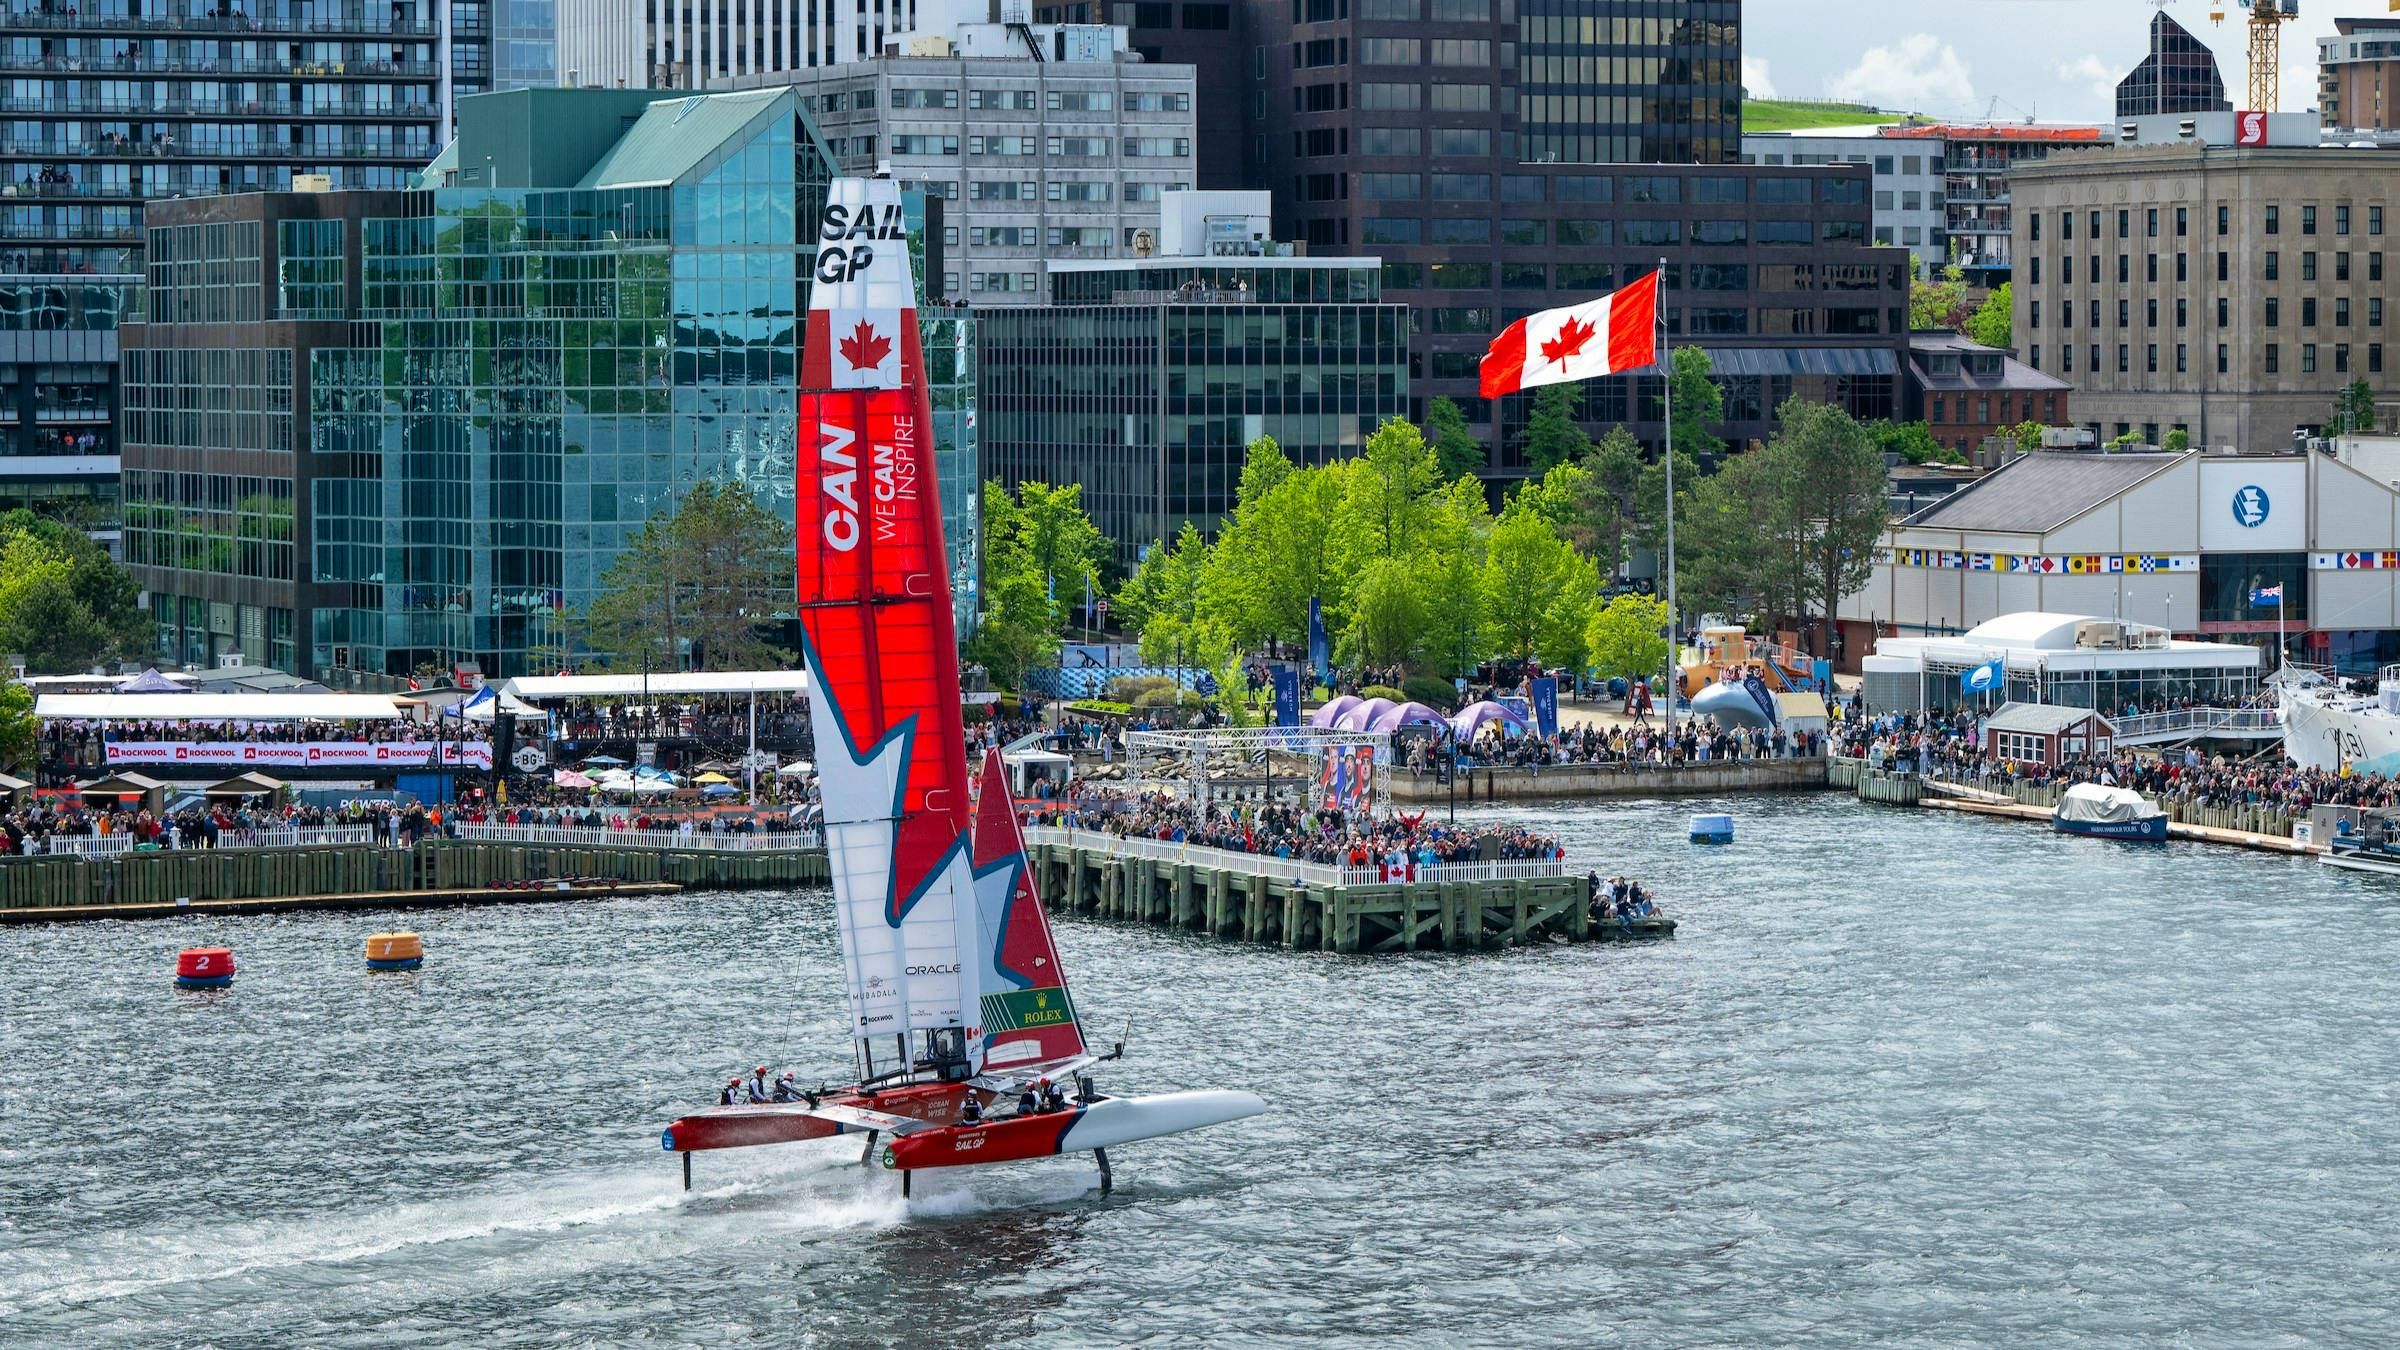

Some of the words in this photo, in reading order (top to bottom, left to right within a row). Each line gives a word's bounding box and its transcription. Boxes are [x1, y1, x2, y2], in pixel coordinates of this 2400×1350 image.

[821, 204, 906, 241] SAIL
[816, 246, 873, 284] GP
[894, 414, 917, 501] INSPIRE
[872, 444, 896, 503] CAN
[820, 425, 860, 552] CAN
[876, 504, 897, 541] WE
[189, 749, 236, 757] ROCKWOOL
[522, 753, 537, 765] BG
[383, 941, 393, 955] 1
[195, 956, 210, 971] 2
[905, 963, 960, 976] ORACLE
[852, 988, 897, 1001] MUBADALA
[868, 1014, 894, 1023] ROCKWOOL
[1024, 1009, 1062, 1024] ROLEX
[927, 1108, 947, 1118] WISE
